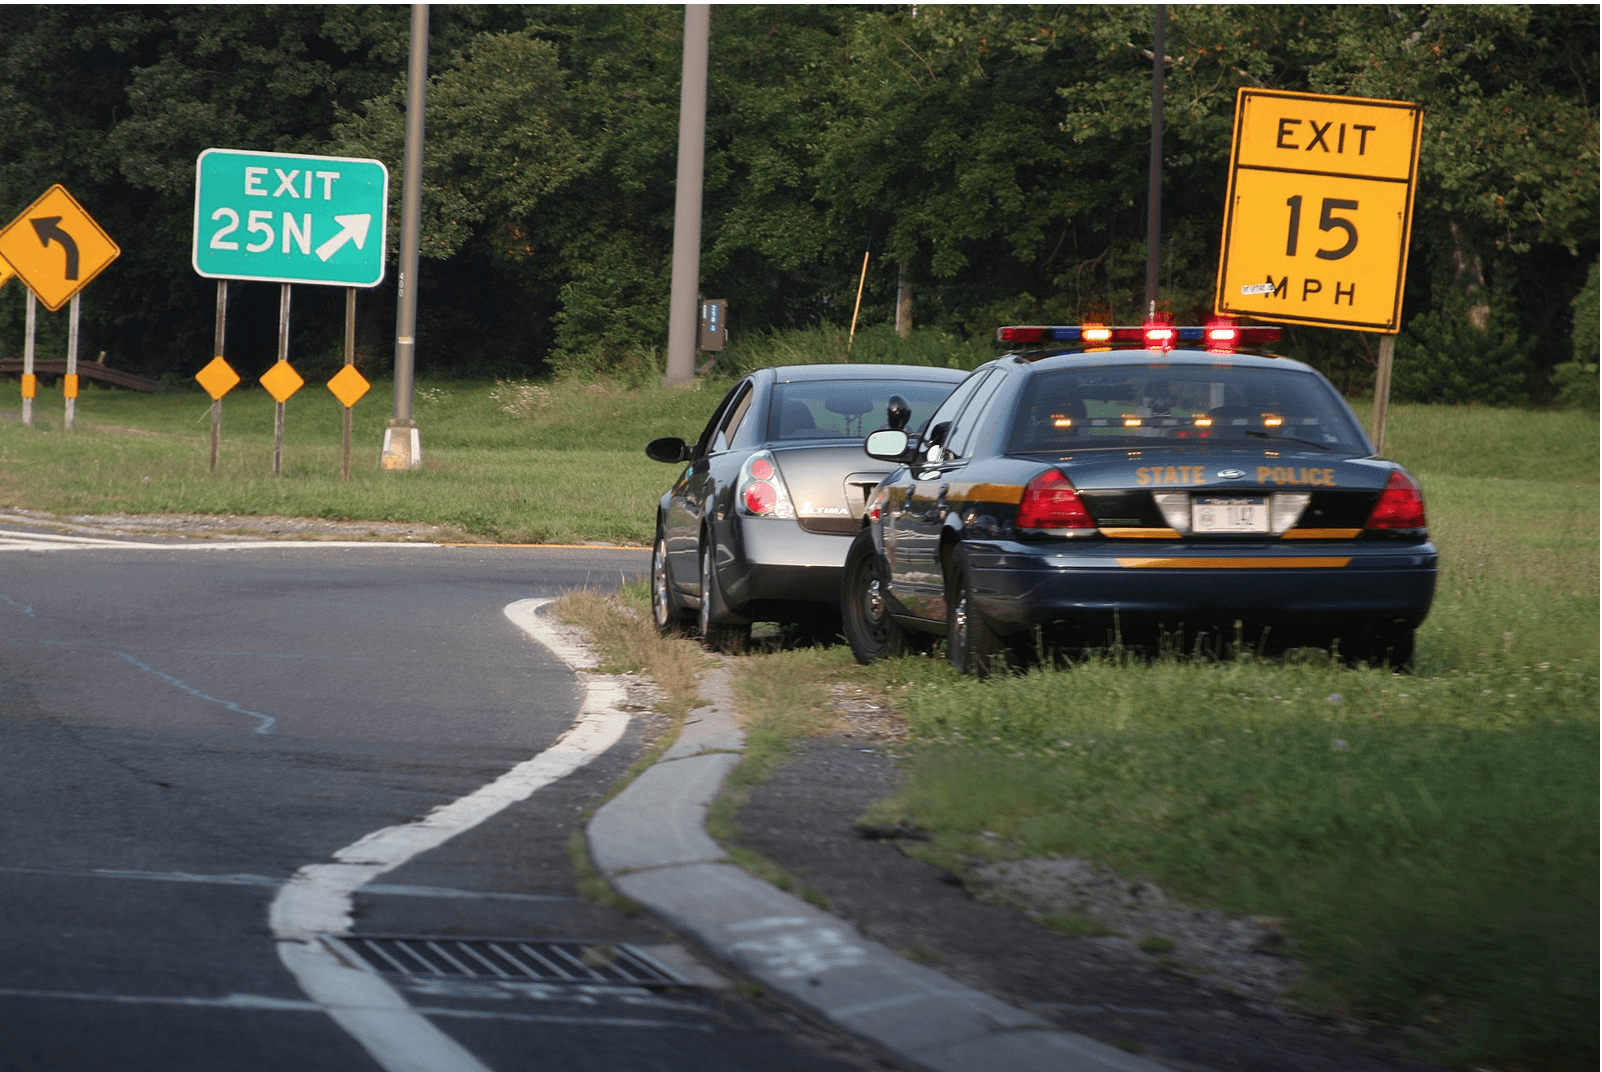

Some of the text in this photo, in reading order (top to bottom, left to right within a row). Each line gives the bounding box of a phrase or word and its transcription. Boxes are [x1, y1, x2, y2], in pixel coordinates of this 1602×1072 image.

[1276, 117, 1376, 156] EXIT
[244, 166, 341, 201] EXIT
[209, 207, 312, 255] 25N
[1285, 194, 1359, 261] 15
[1264, 274, 1356, 306] MPH
[1136, 465, 1206, 485] STATE
[1256, 466, 1337, 487] POLICE
[799, 506, 849, 515] ALTIMA
